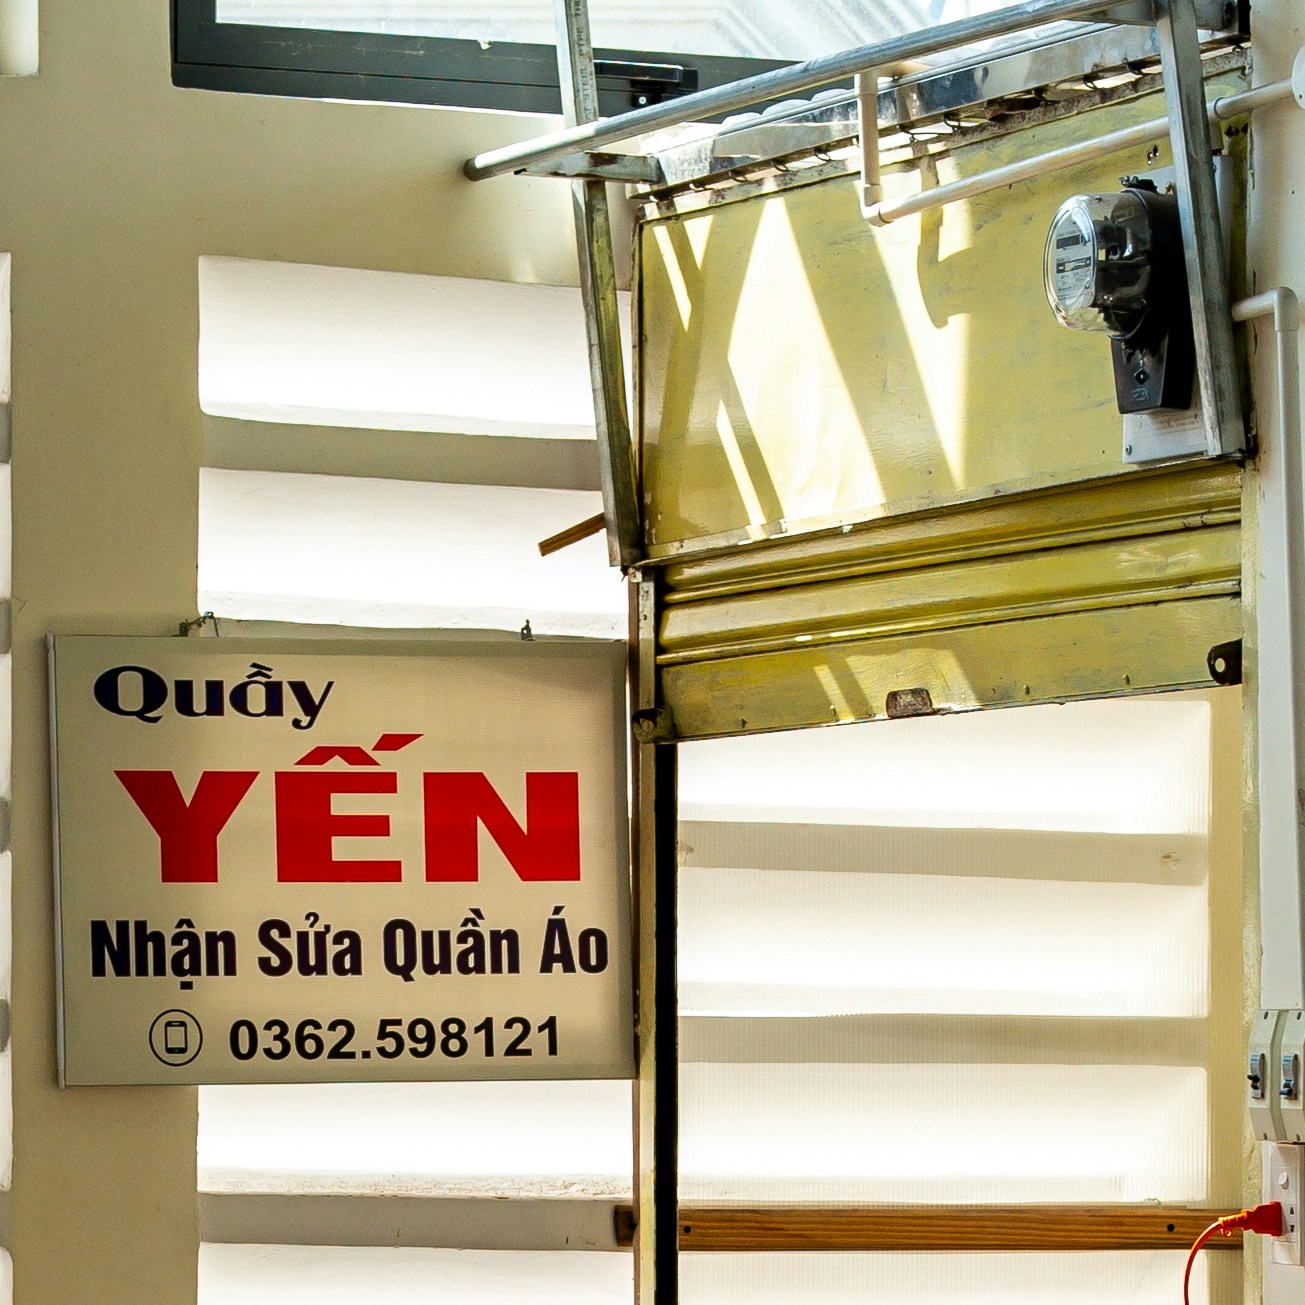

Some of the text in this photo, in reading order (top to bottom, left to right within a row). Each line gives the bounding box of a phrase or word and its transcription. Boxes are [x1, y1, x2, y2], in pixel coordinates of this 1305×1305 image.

[93, 662, 334, 730] Quầy
[113, 733, 581, 883] YẾN
[90, 905, 609, 990] Nhận Sửa Quần Áo
[228, 1015, 559, 1061] 0362.598121
